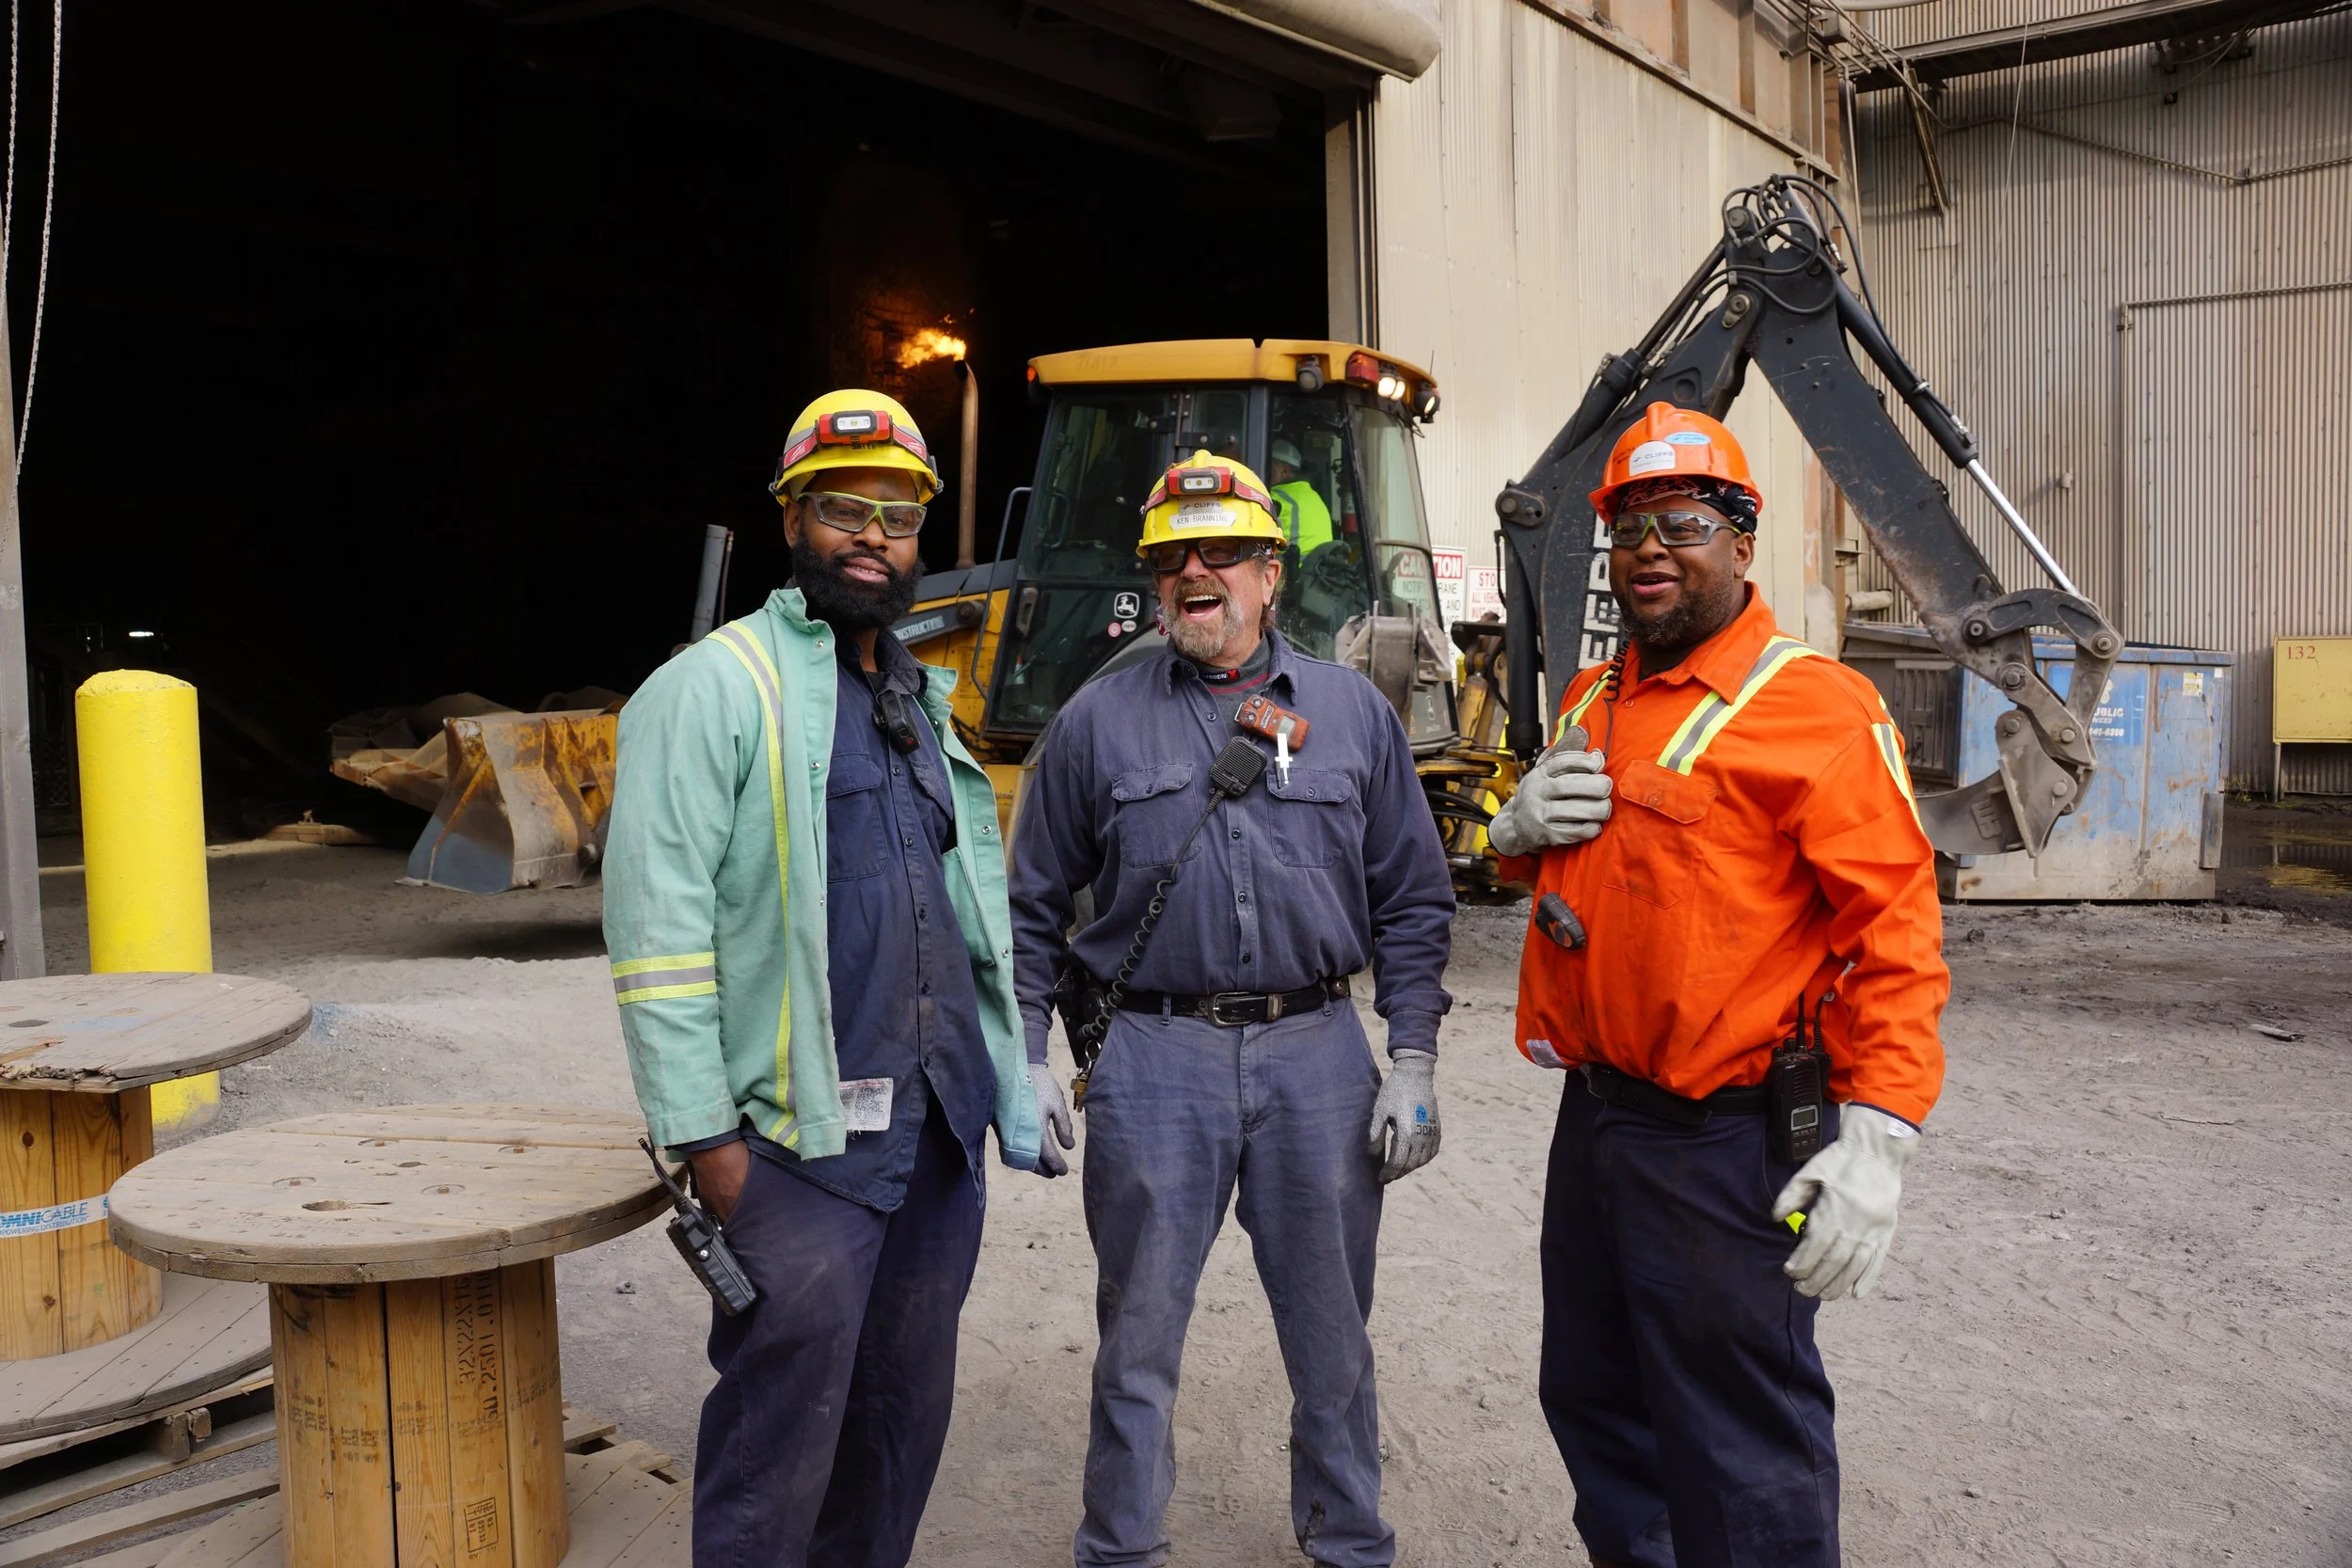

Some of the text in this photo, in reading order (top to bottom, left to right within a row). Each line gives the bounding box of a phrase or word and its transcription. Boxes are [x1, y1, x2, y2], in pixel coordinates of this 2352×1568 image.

[1176, 514, 1228, 525] KEN BRANNING
[2288, 645, 2315, 659] 132
